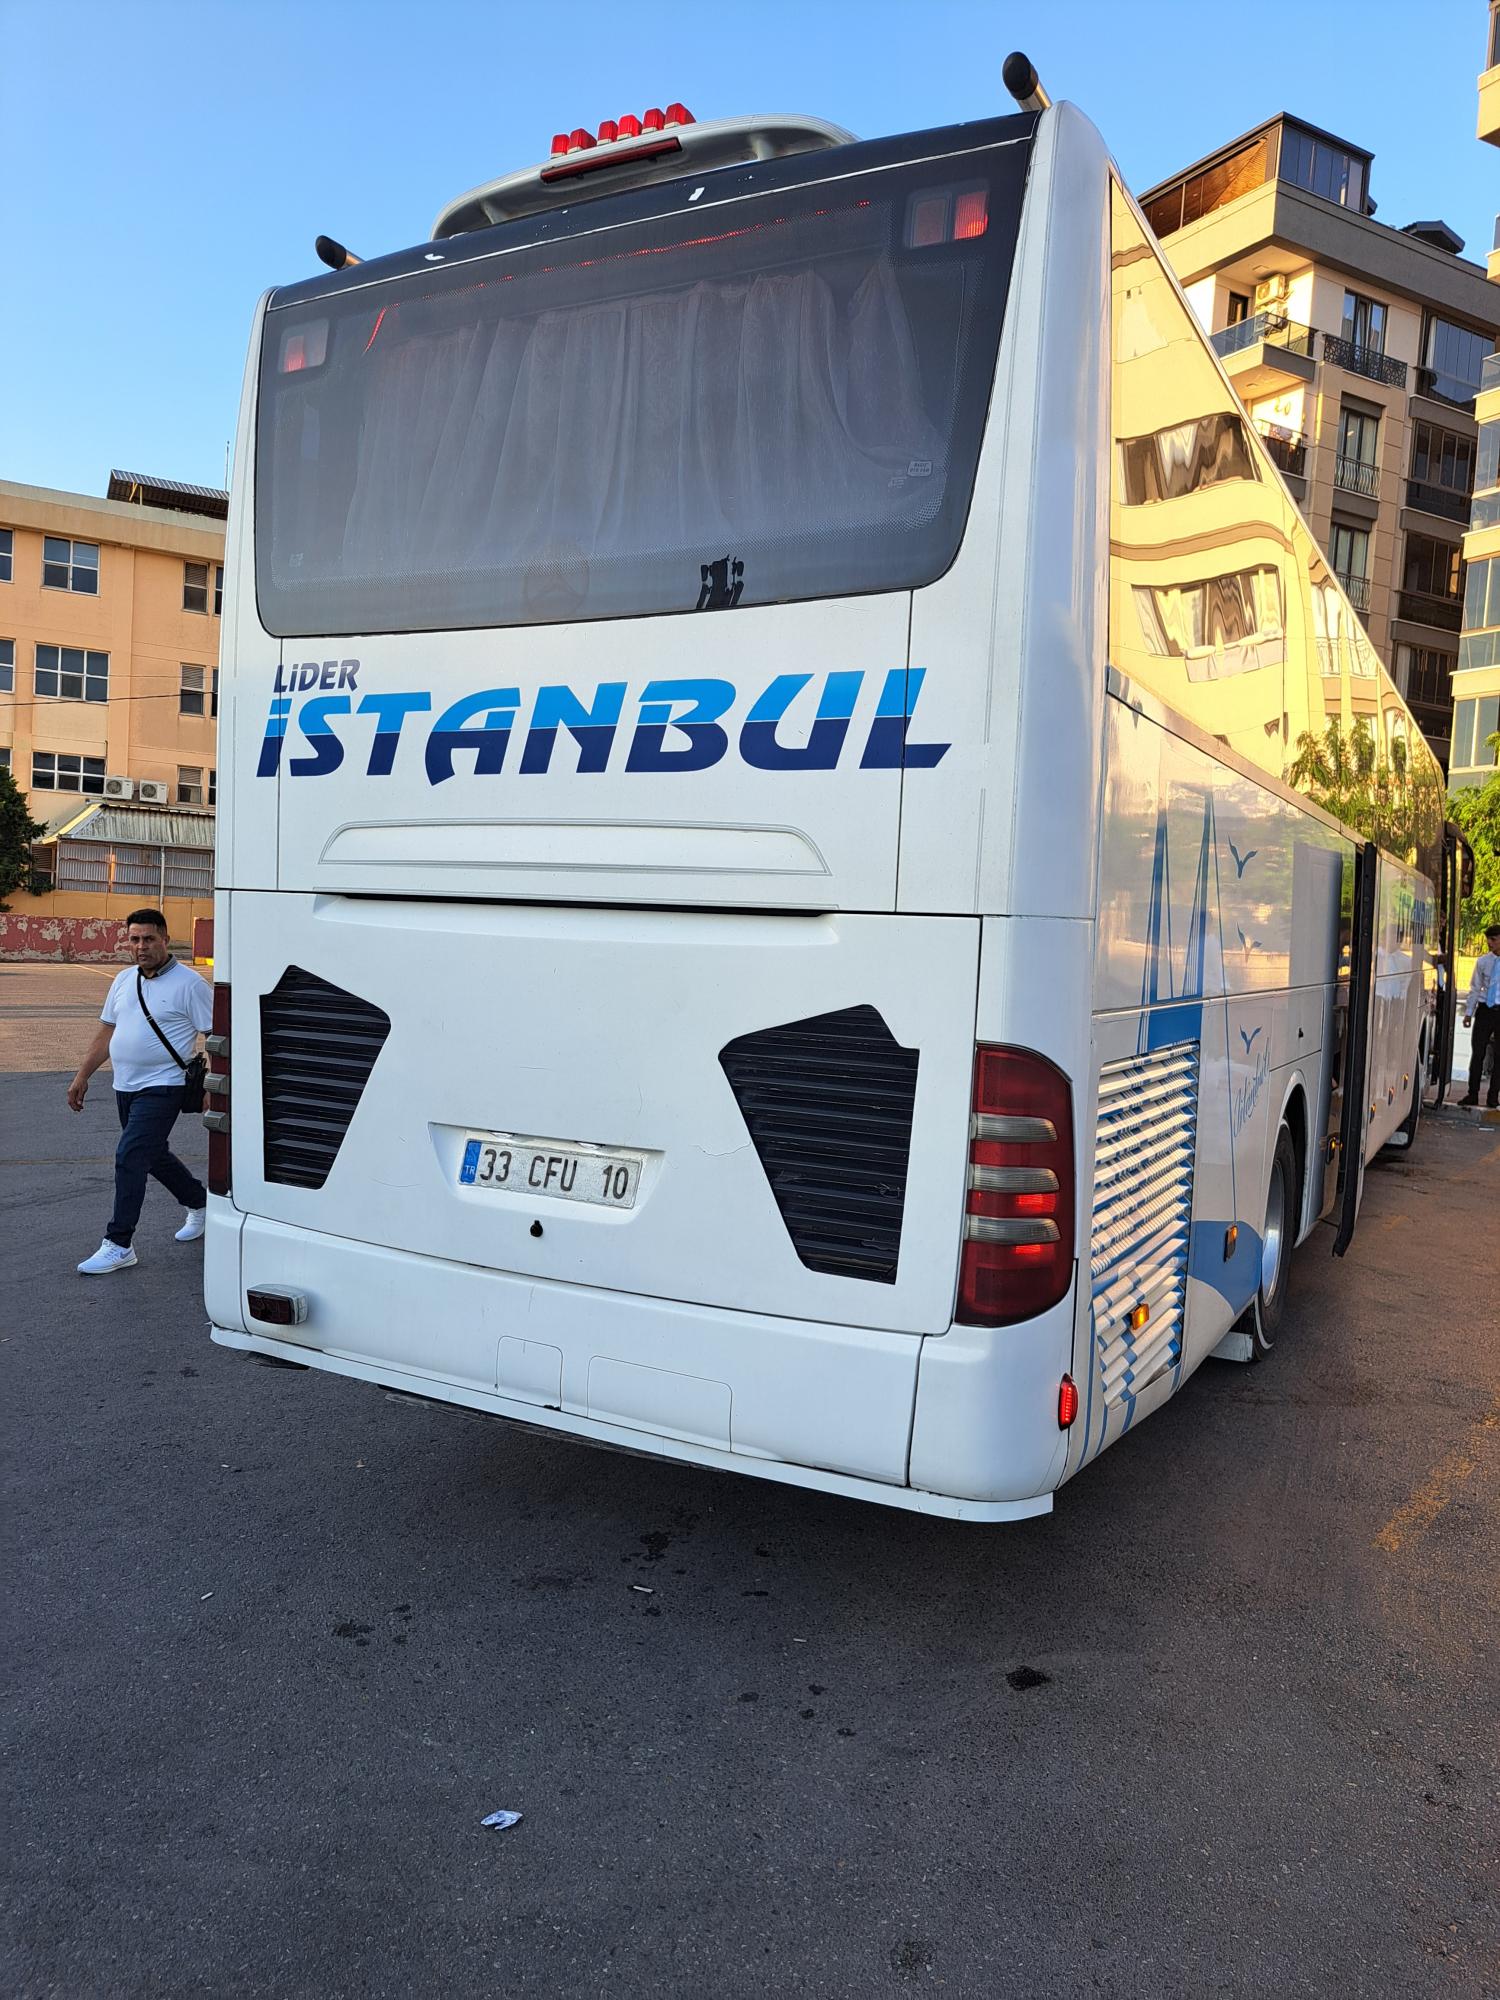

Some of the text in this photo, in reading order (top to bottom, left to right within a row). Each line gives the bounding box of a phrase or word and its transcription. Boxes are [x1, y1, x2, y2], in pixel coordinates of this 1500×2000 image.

[464, 1165, 476, 1176] TR
[480, 1149, 630, 1200] 33 CFU 10
